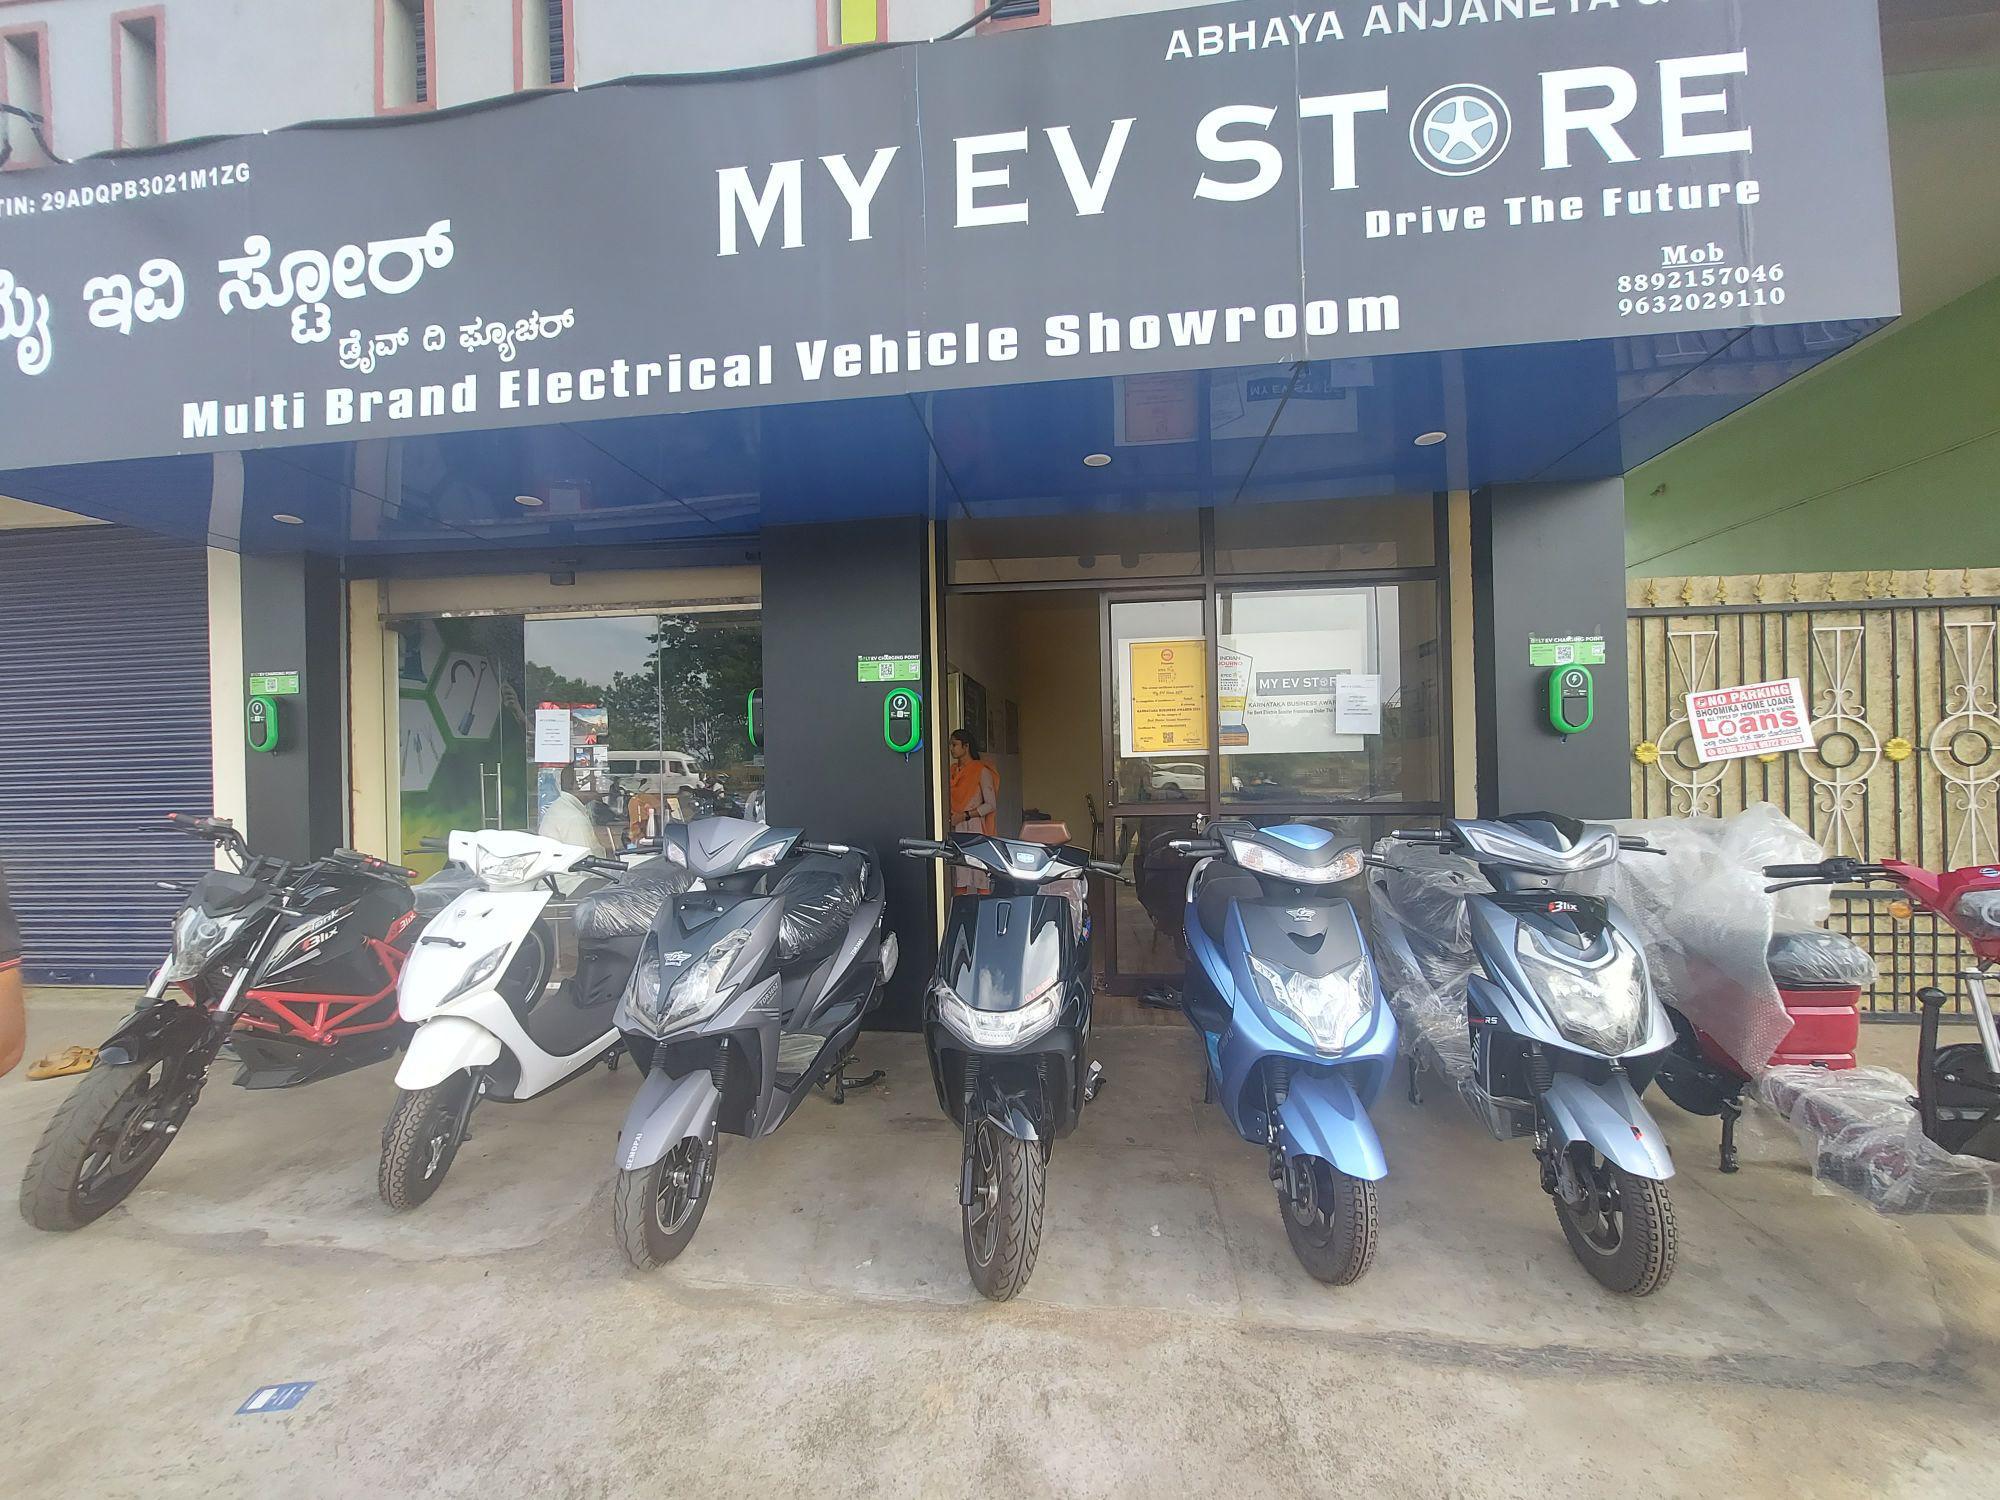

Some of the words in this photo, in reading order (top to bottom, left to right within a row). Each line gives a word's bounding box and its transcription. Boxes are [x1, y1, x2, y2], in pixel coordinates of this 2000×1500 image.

[1165, 11, 1344, 61] ABHAYA
[41, 162, 250, 212] 29ADQPB3021M1ZG
[715, 145, 901, 257] MY
[953, 117, 1137, 229] EV
[1365, 206, 1486, 239] Drive
[1503, 195, 1583, 227] The
[1602, 180, 1760, 217] Future
[1660, 242, 1725, 267] Mob
[83, 258, 185, 336] ಇವಿ
[218, 219, 454, 344] ಸ್ಟೋರ್
[1617, 263, 1784, 293] 8892157046
[1618, 287, 1785, 317] 9632029110
[182, 392, 304, 439] Multi
[325, 374, 477, 426] Brand
[499, 344, 772, 410] Electrical
[795, 322, 1019, 381] Vehicle
[1045, 293, 1401, 357] Showroom
[338, 327, 410, 375] ಡ್ರೈವ್
[422, 324, 446, 352] ದಿ
[1259, 678, 1279, 689] MY
[1282, 677, 1300, 689] EV
[1707, 694, 1727, 707] NO
[1730, 684, 1791, 704] PARKING
[1695, 704, 1740, 718] BHOOMIKA
[1740, 700, 1765, 710] HOME
[1766, 696, 1794, 707] LOANS
[1698, 710, 1799, 739] Loans
